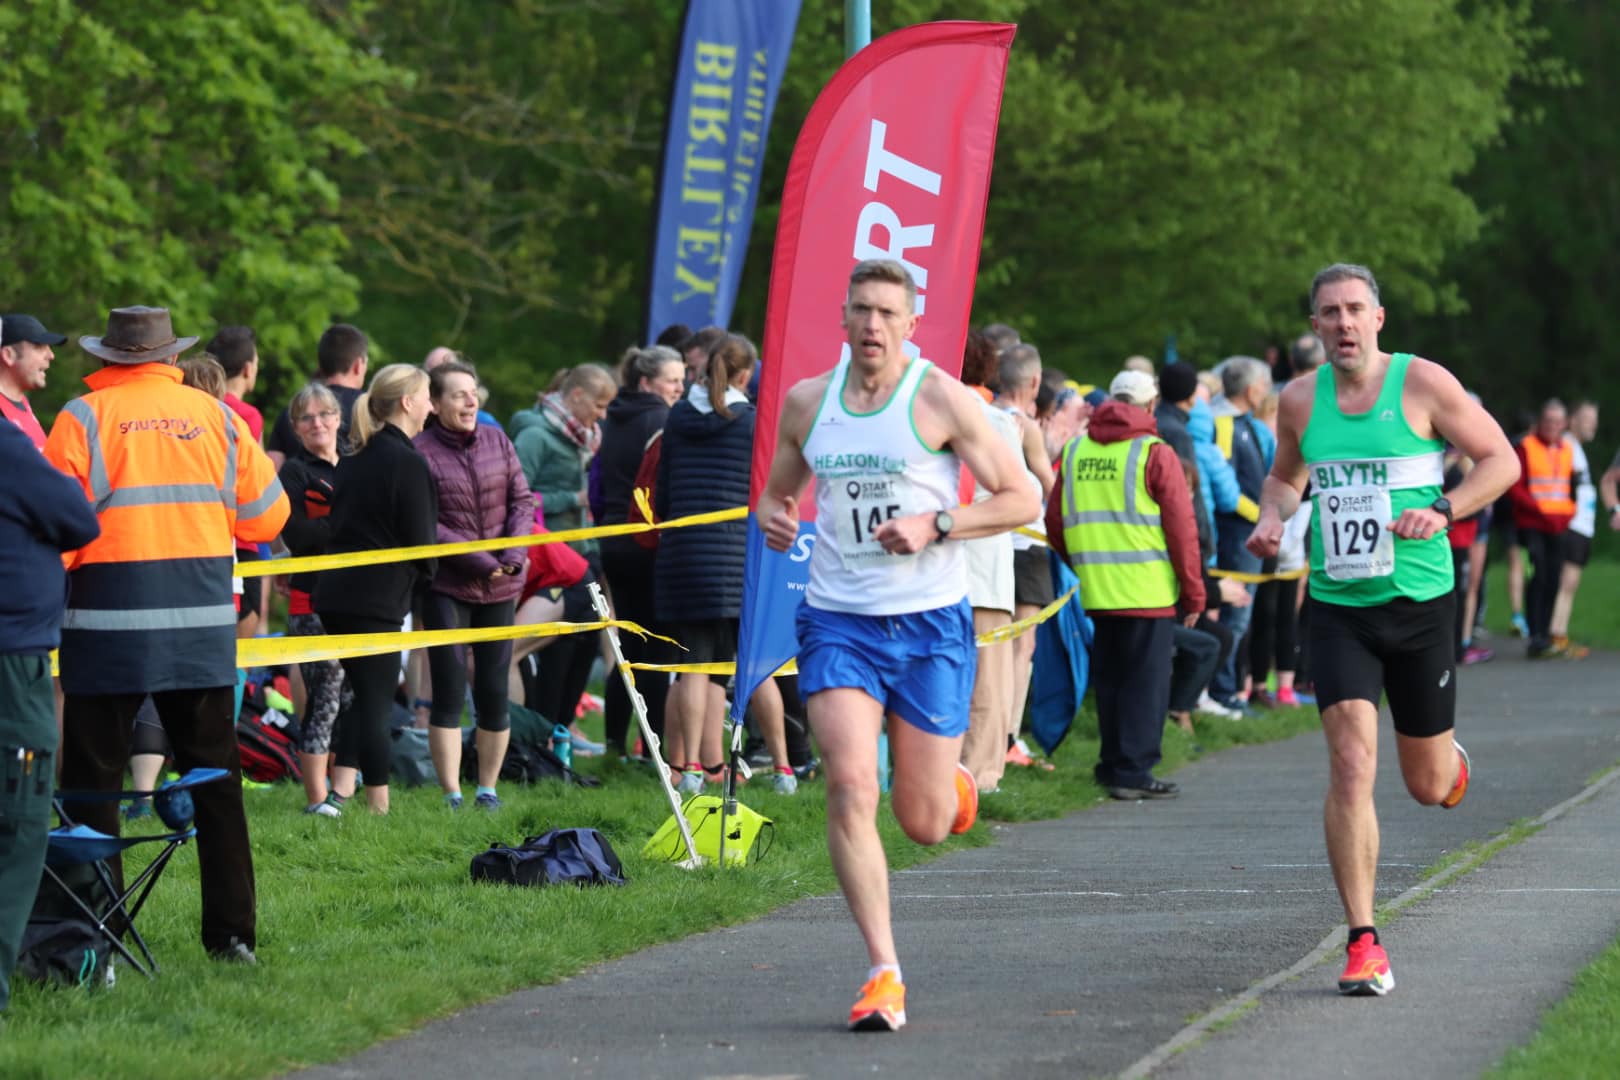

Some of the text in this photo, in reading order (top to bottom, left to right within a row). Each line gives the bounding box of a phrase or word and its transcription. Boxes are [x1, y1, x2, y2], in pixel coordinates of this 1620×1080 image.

[119, 418, 188, 434] saucony
[814, 453, 880, 470] HEATON
[1078, 457, 1117, 472] OFFICIAL
[1316, 463, 1387, 489] BLYTH
[862, 480, 896, 492] START
[1341, 495, 1373, 506] START
[1332, 518, 1380, 556] 129
